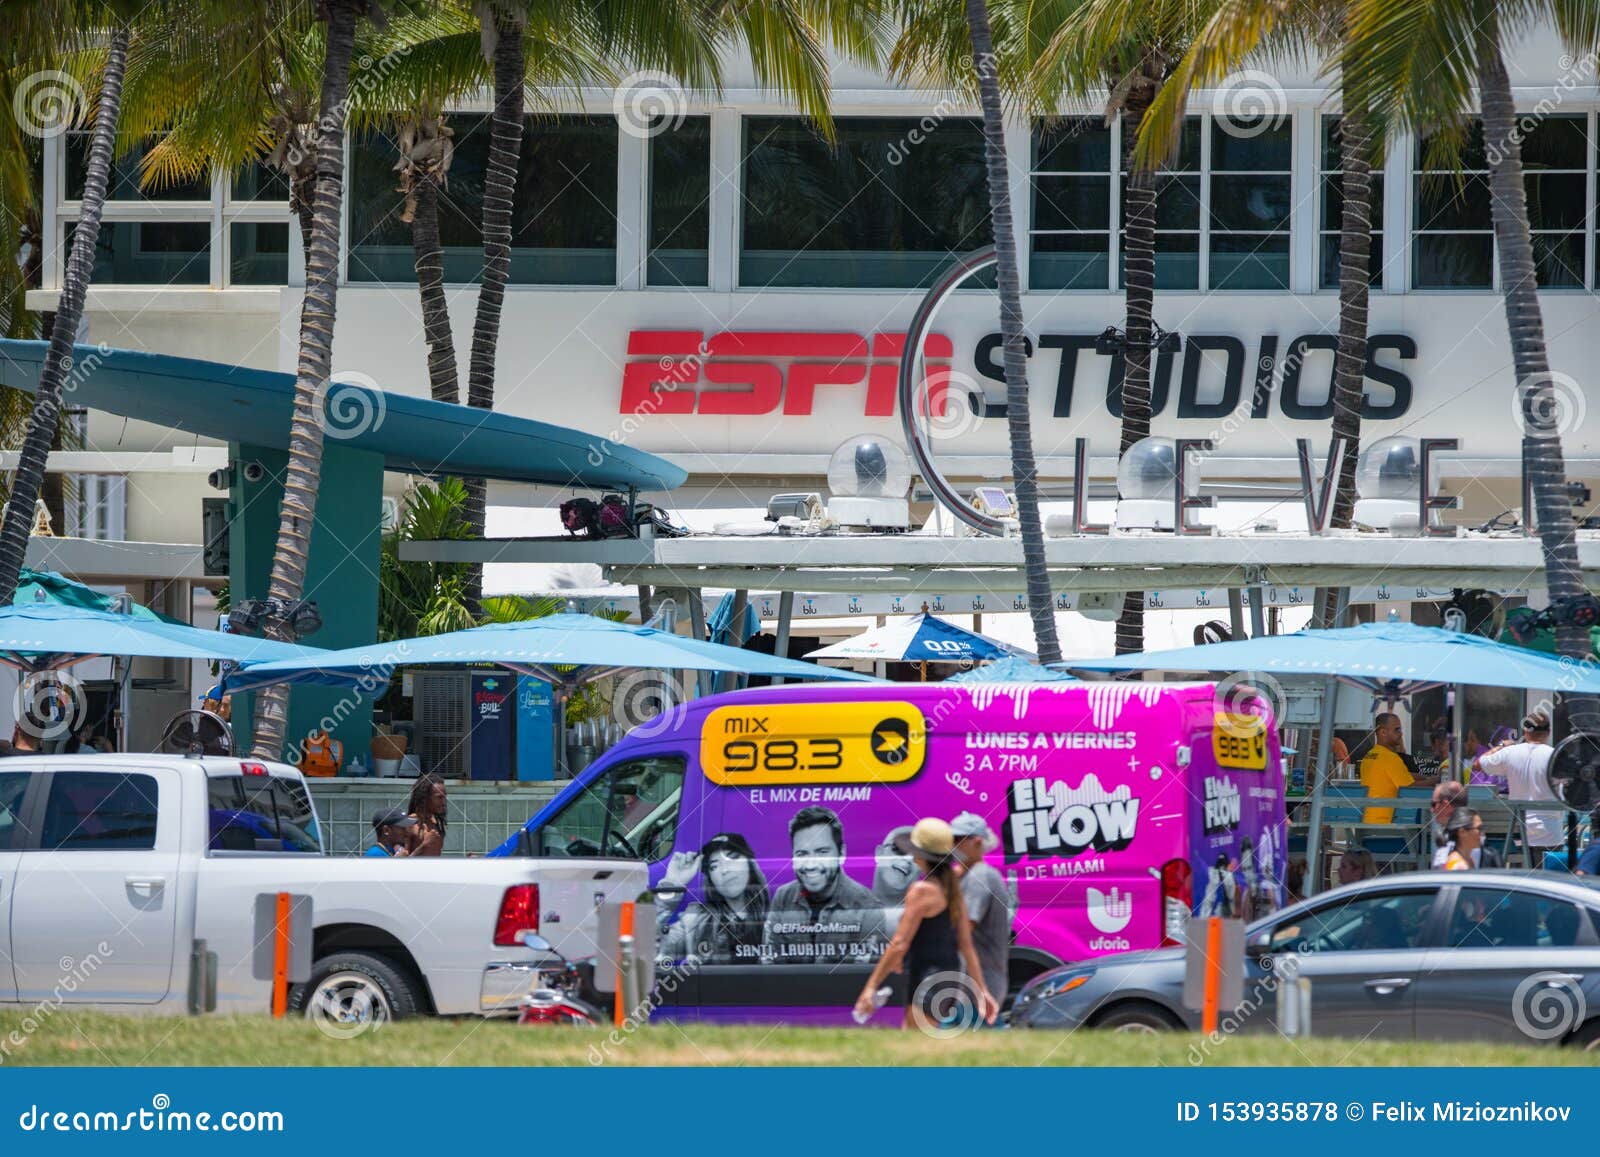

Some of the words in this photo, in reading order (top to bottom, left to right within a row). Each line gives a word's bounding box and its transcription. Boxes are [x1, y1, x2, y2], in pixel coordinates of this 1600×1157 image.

[619, 330, 953, 417] ESPN
[968, 333, 1418, 420] STUDIOS
[1288, 593, 1303, 604] blu
[1377, 590, 1391, 600] blu
[1416, 588, 1428, 599] blu
[932, 600, 945, 612] blu
[973, 599, 985, 611] blu
[1013, 598, 1026, 610] blu
[1057, 598, 1071, 610] blu
[1150, 596, 1164, 608] blu
[1196, 595, 1210, 607] blu
[762, 604, 774, 617] blu
[803, 603, 817, 615] blu
[849, 602, 862, 614] blu
[892, 602, 905, 613] blu
[965, 732, 1030, 749] LUNES
[1032, 733, 1049, 749] A
[1050, 731, 1137, 749] VIERNES
[723, 738, 843, 772] 98.3
[963, 754, 975, 772] 3
[978, 755, 993, 771] A
[998, 754, 1038, 772] 7PM
[750, 789, 767, 804] EL
[770, 788, 797, 803] MIX
[800, 788, 821, 802] DE
[823, 787, 872, 802] MIAMI
[1011, 777, 1055, 811] EL
[1205, 794, 1241, 829] FLOW
[1009, 798, 1141, 854] FLOW
[1025, 865, 1047, 881] DE
[1052, 859, 1105, 877] MIAMI
[773, 922, 861, 934] @ElFlowDeMiami
[1089, 937, 1130, 951] uforia
[735, 943, 778, 959] SANTI,
[780, 943, 835, 957] LAURITA
[838, 943, 847, 956] Y
